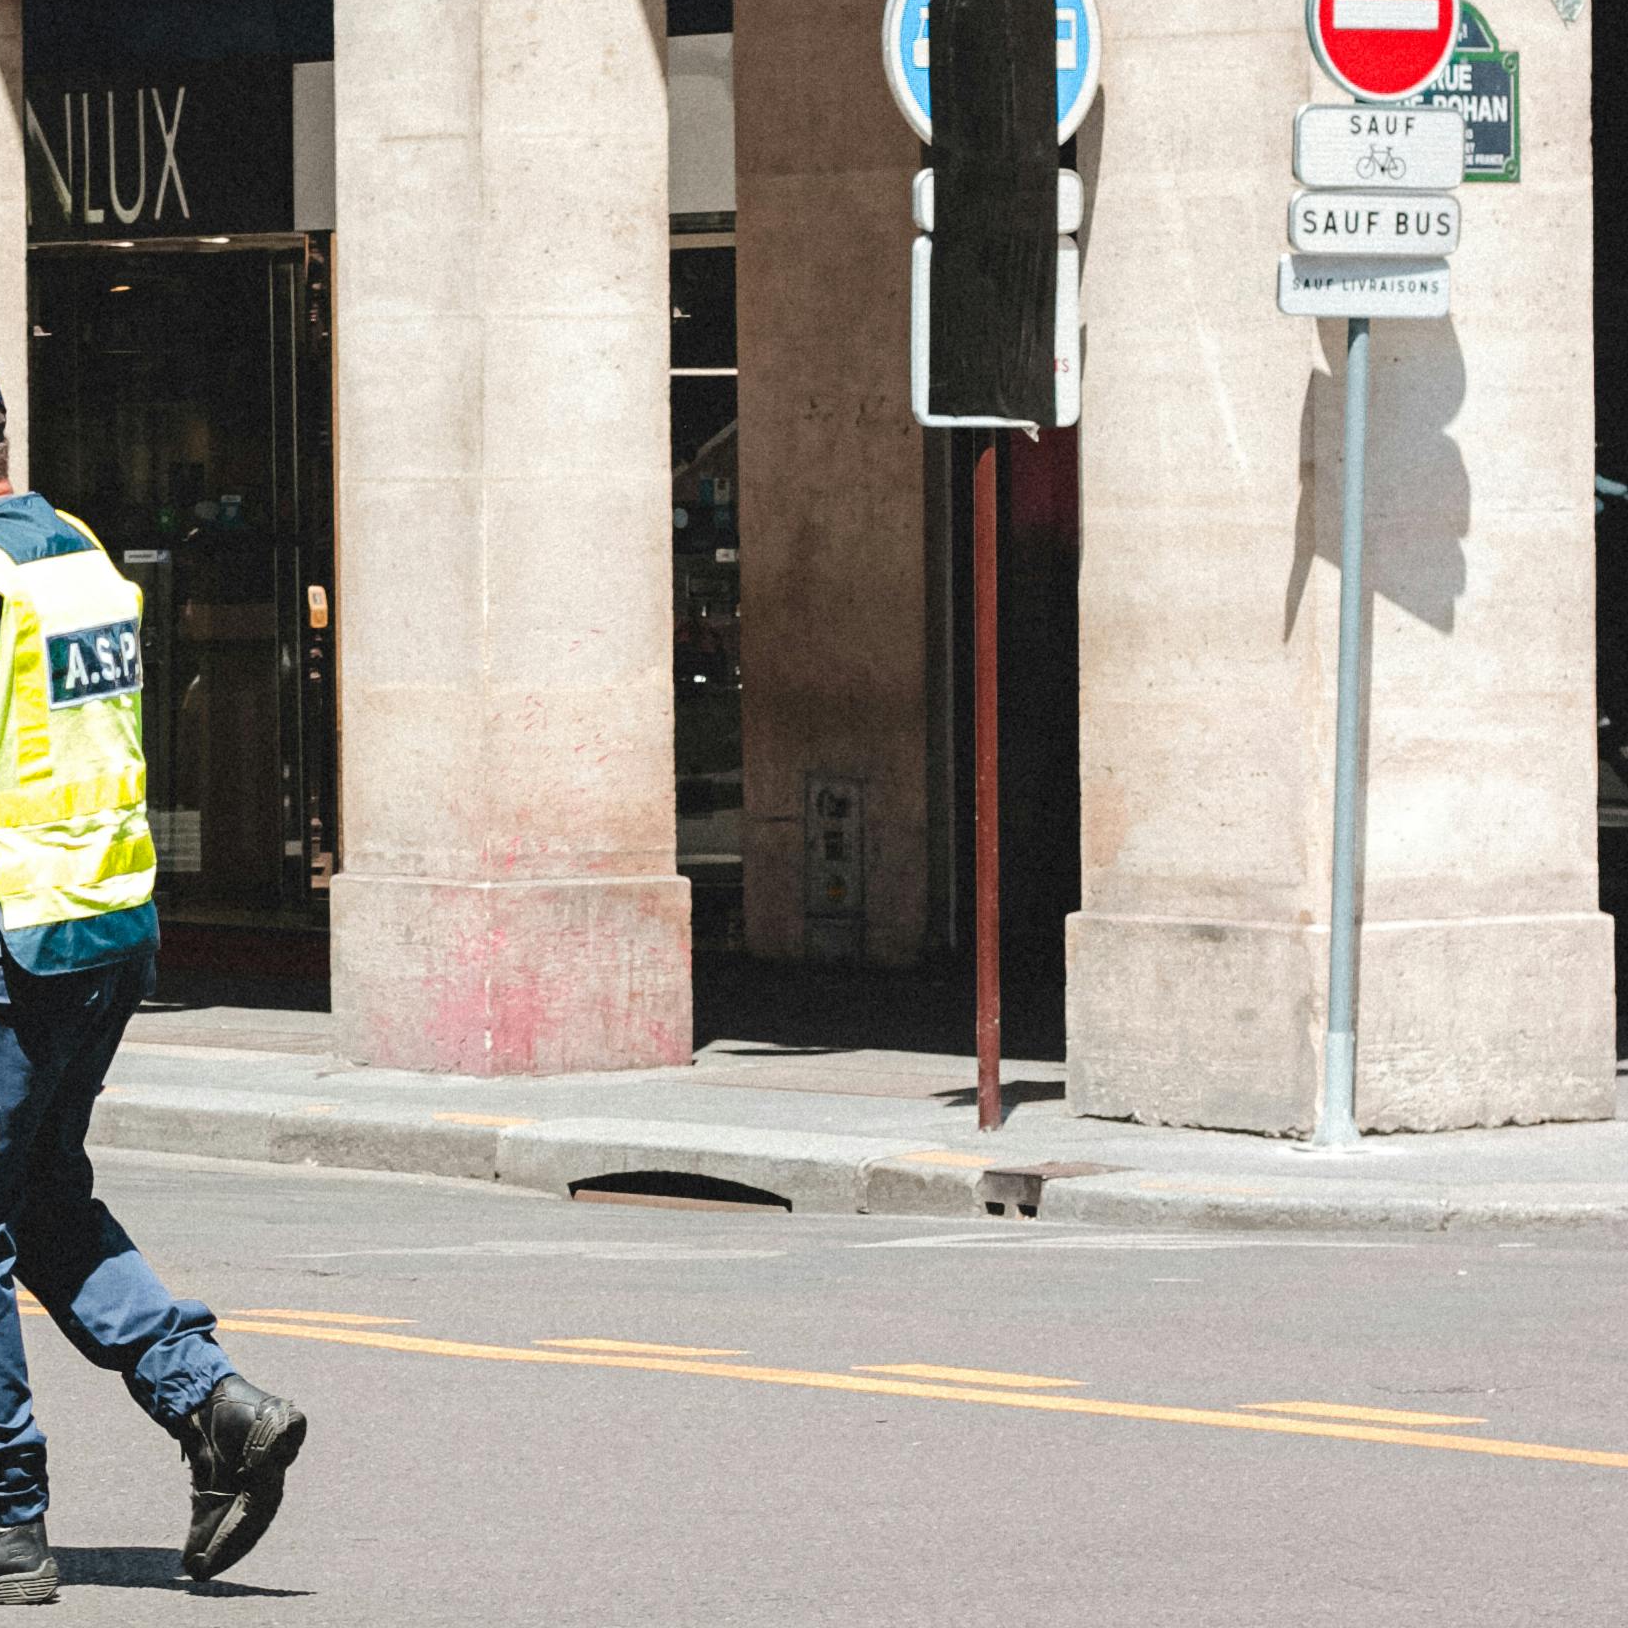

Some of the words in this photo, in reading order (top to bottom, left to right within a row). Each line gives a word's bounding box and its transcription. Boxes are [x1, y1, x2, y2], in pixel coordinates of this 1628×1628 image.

[1350, 115, 1416, 135] SAUF
[1303, 210, 1380, 234] SAUF
[1396, 212, 1451, 236] BUS
[1292, 278, 1333, 290] SAUF
[1342, 279, 1439, 294] LIVRAISONS
